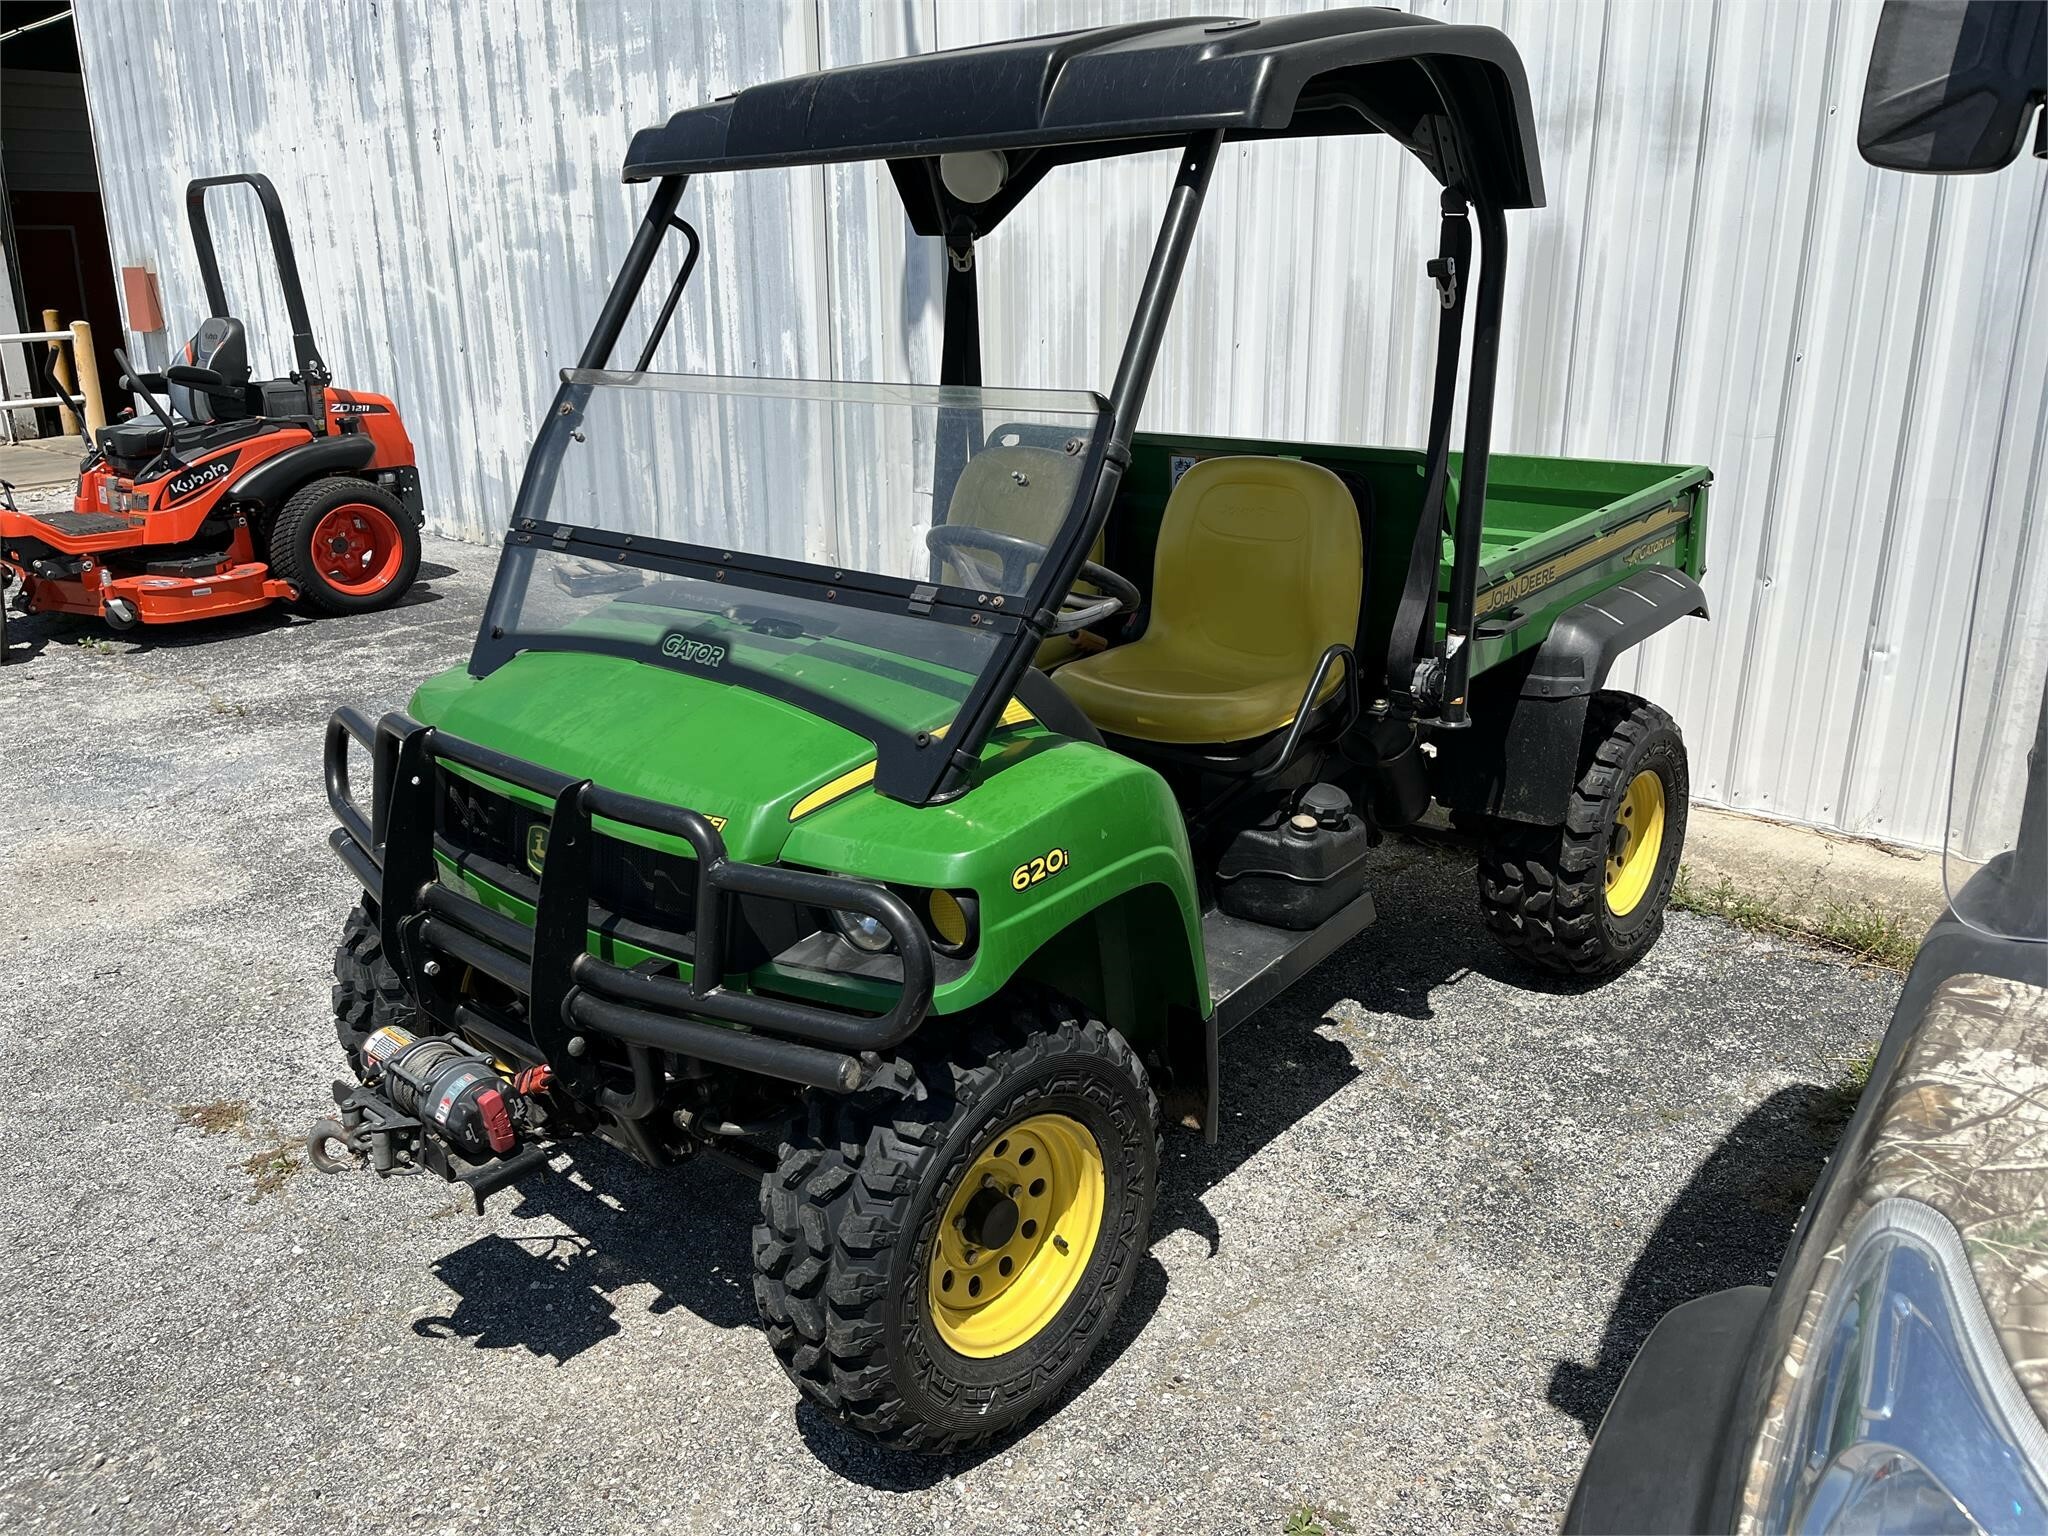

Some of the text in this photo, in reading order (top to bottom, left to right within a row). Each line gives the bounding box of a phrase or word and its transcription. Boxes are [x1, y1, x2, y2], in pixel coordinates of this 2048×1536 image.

[330, 403, 370, 413] ZD 1211
[170, 463, 229, 493] Kubota
[1487, 565, 1557, 611] JOHN DEERE
[662, 633, 725, 667] GATOR
[1011, 848, 1069, 891] 620i
